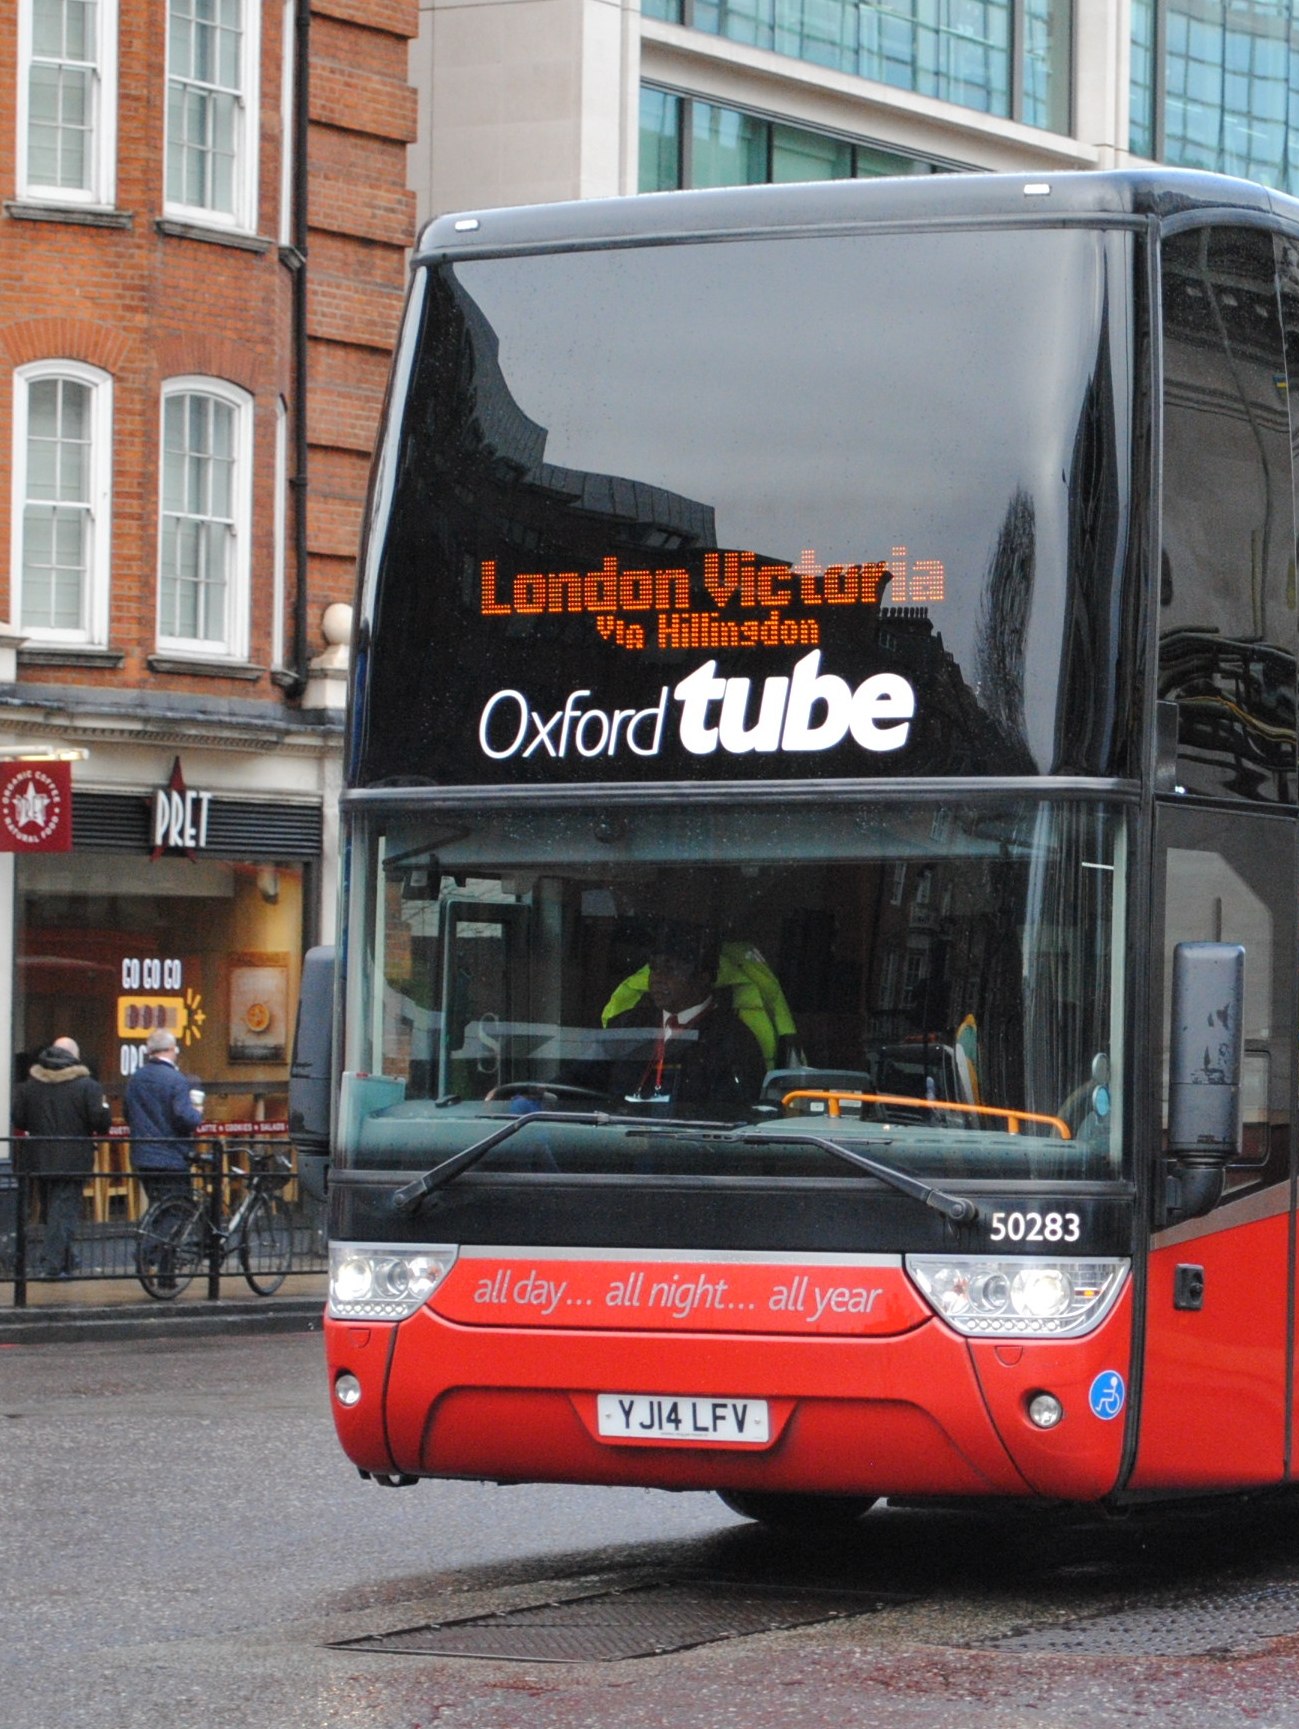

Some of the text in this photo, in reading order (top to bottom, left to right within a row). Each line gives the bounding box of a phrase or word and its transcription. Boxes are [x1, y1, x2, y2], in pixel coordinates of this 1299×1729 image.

[481, 545, 946, 616] London Victoria
[657, 610, 822, 650] Hillingdon
[479, 648, 916, 760] Oxford tube
[34, 770, 61, 803] COFFEE
[40, 815, 60, 840] FOOD
[155, 790, 212, 848] PRET
[122, 958, 181, 989] GO GO GO
[990, 1212, 1080, 1242] 50283
[474, 1269, 508, 1303] all
[606, 1272, 640, 1307] all
[769, 1276, 805, 1313] all
[806, 1286, 882, 1322] year
[618, 1400, 748, 1433] YJ14 LFV
